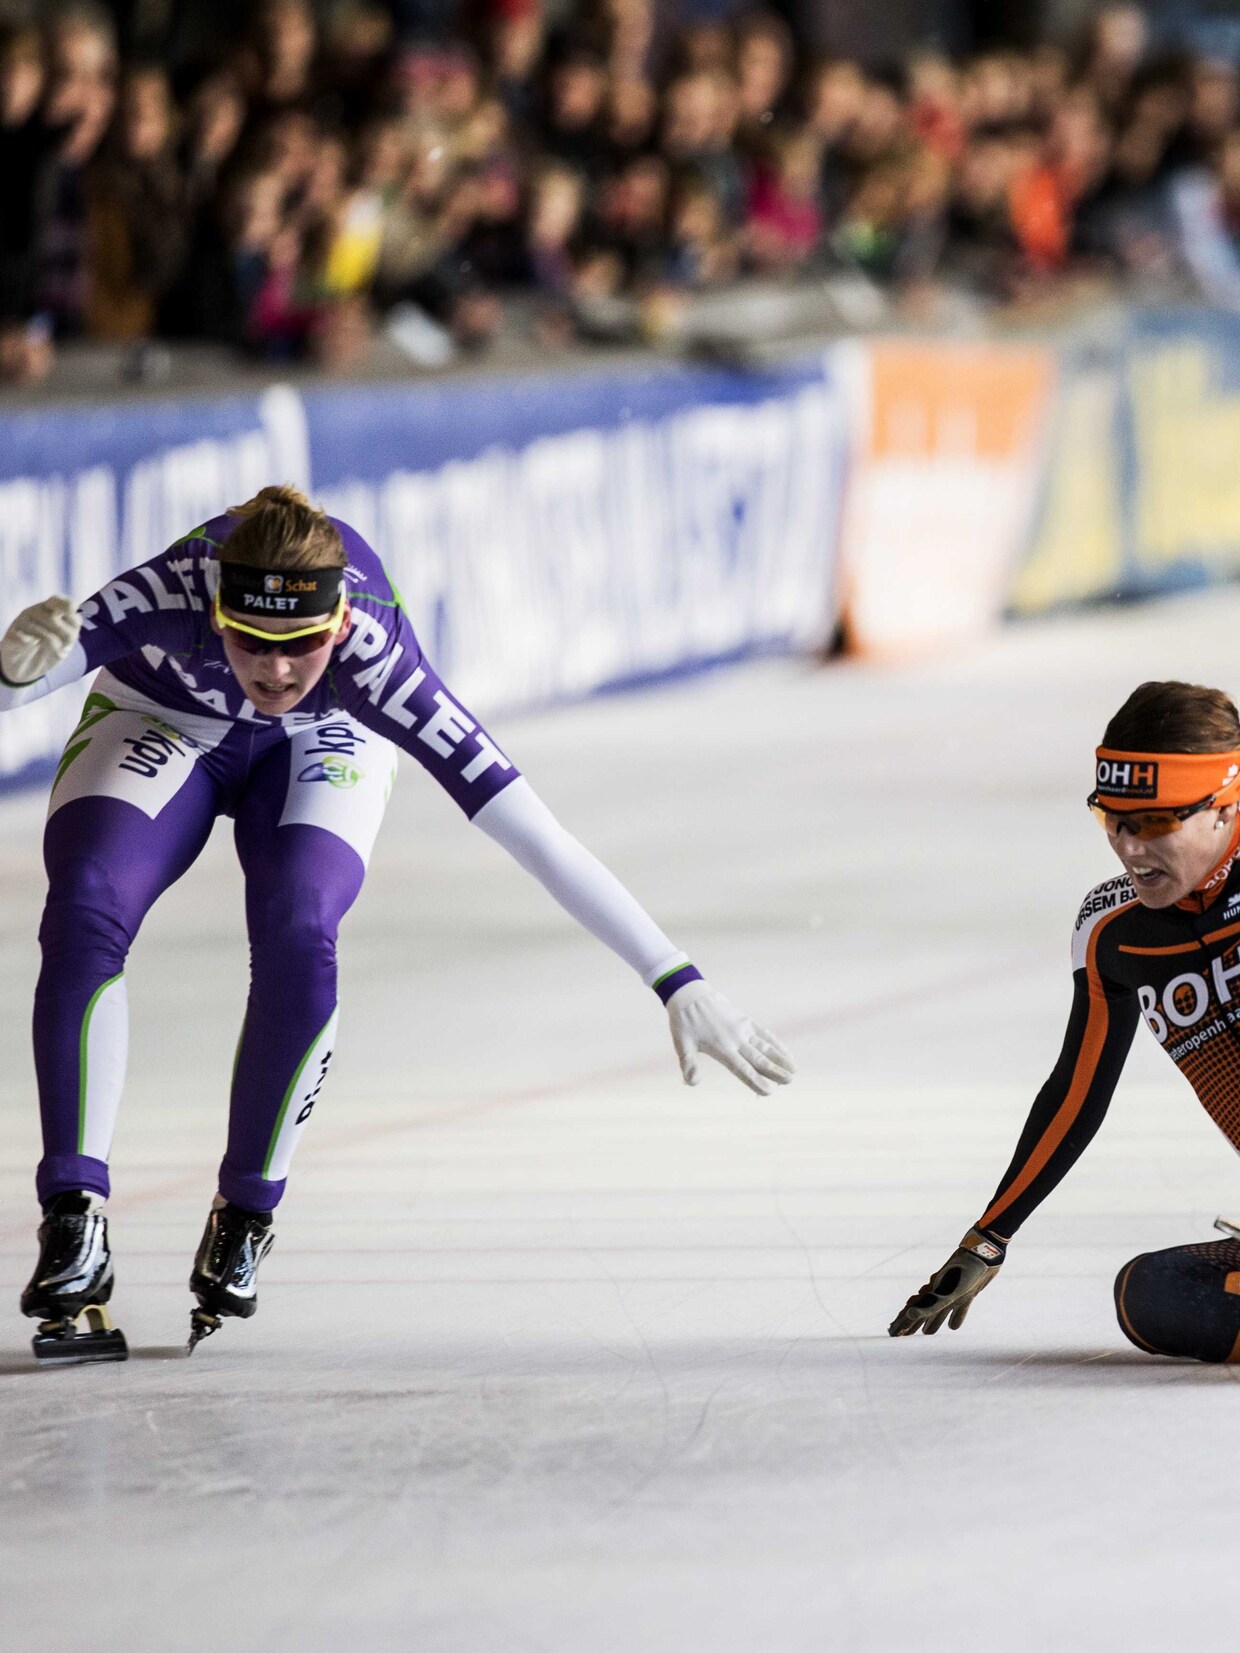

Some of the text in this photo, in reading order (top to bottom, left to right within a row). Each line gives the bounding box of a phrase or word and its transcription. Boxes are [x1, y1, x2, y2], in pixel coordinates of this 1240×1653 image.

[285, 578, 318, 592] Schat
[243, 593, 299, 611] PALET
[339, 607, 512, 784] PALET
